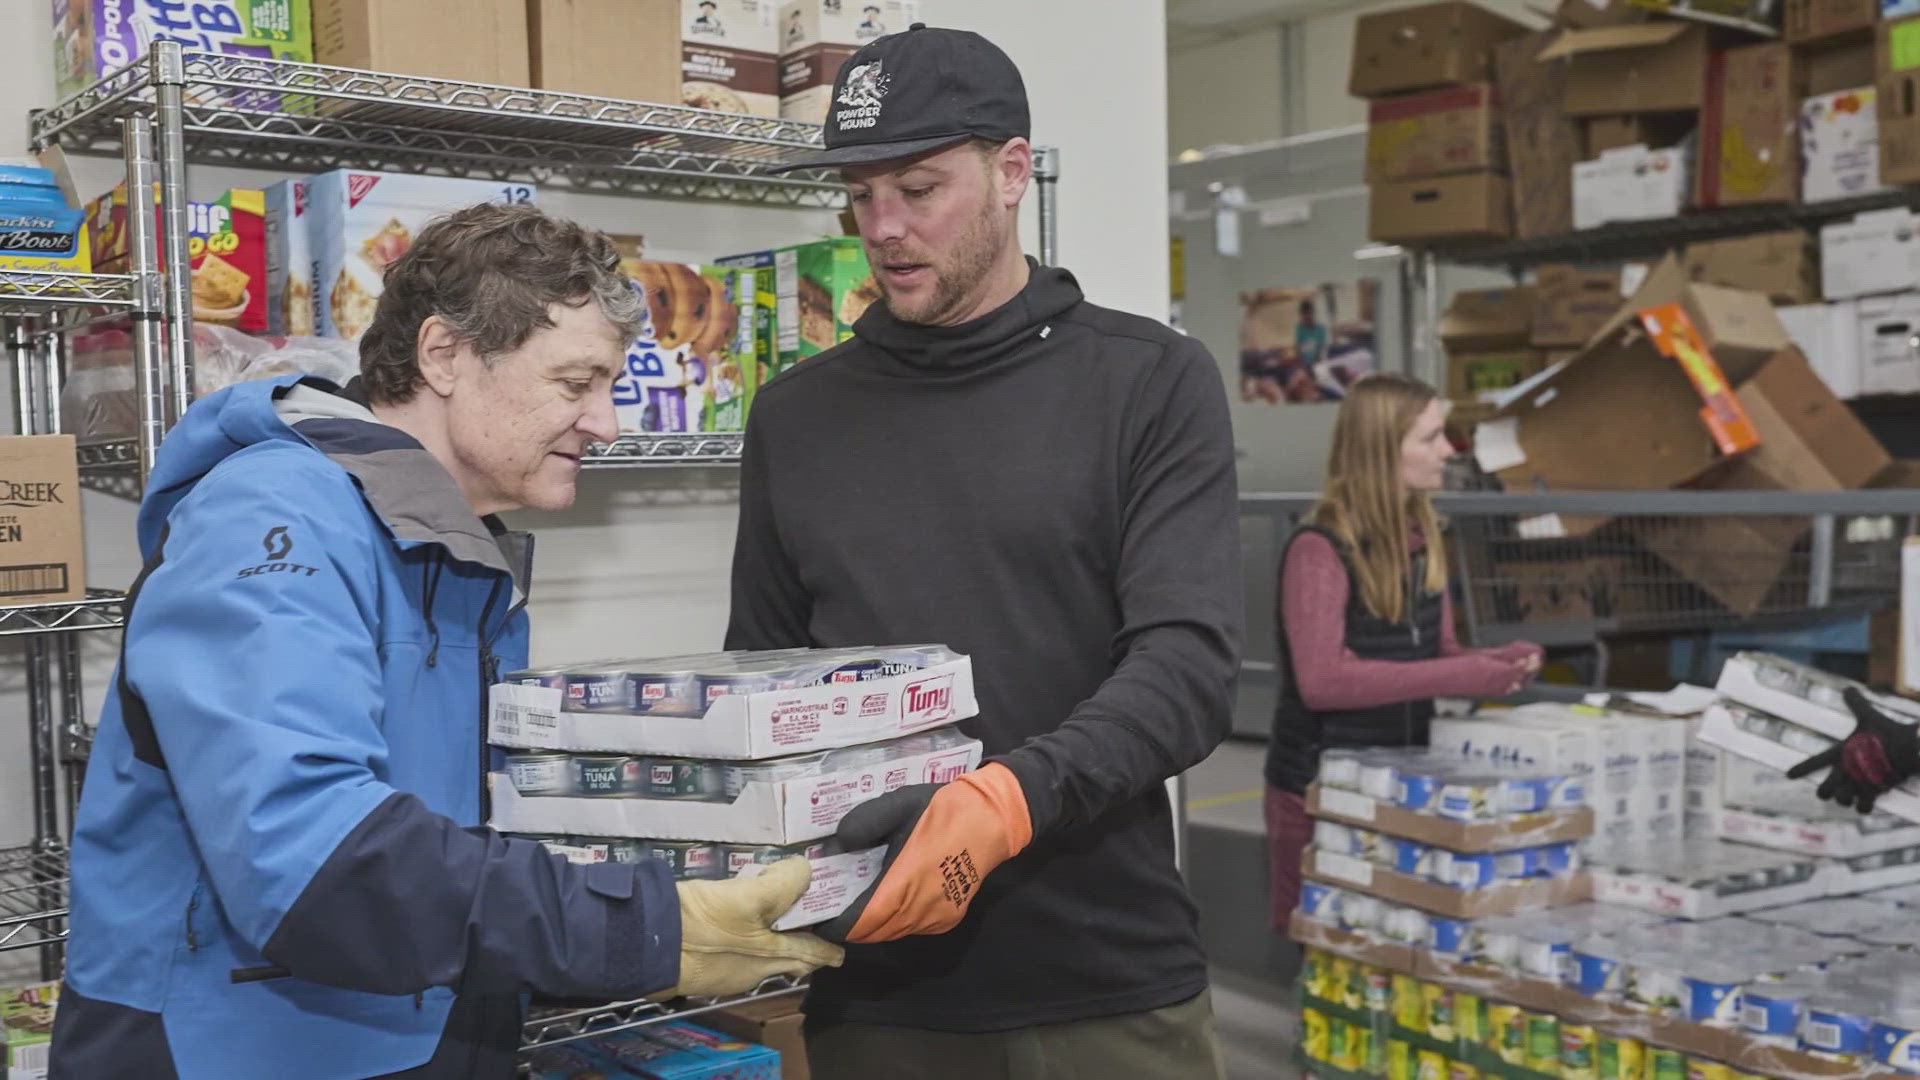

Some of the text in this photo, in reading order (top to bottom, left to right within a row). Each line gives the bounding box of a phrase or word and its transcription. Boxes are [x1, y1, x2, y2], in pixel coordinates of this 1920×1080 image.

[836, 107, 881, 122] POWDER
[839, 117, 877, 131] HOUND
[502, 187, 530, 204] 12
[208, 233, 239, 253] GO
[236, 562, 320, 580] SCOTT
[907, 685, 951, 713] Tuny
[585, 773, 616, 783] TUNA
[653, 767, 672, 782] Tuny
